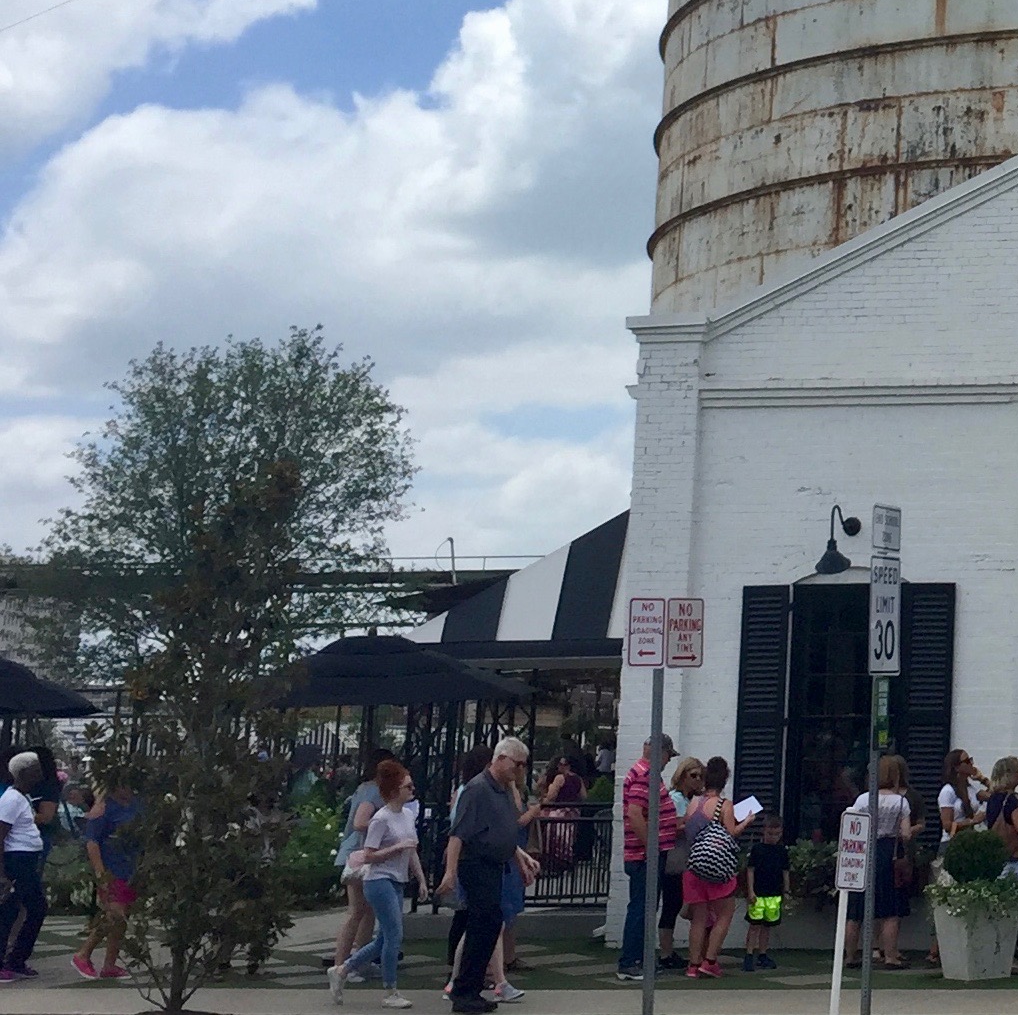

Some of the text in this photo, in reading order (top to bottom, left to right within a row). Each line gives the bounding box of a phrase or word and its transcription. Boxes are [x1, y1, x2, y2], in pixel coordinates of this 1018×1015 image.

[873, 565, 898, 585] SPEED
[641, 602, 655, 612] NO
[678, 603, 693, 617] NO
[875, 596, 896, 614] LIMIT
[632, 615, 662, 624] PARKING
[669, 618, 702, 632] PARKING
[638, 637, 655, 645] ZONE
[677, 632, 692, 642] ANY
[873, 619, 896, 660] 30
[676, 643, 693, 653] TIME
[849, 820, 862, 836] NO
